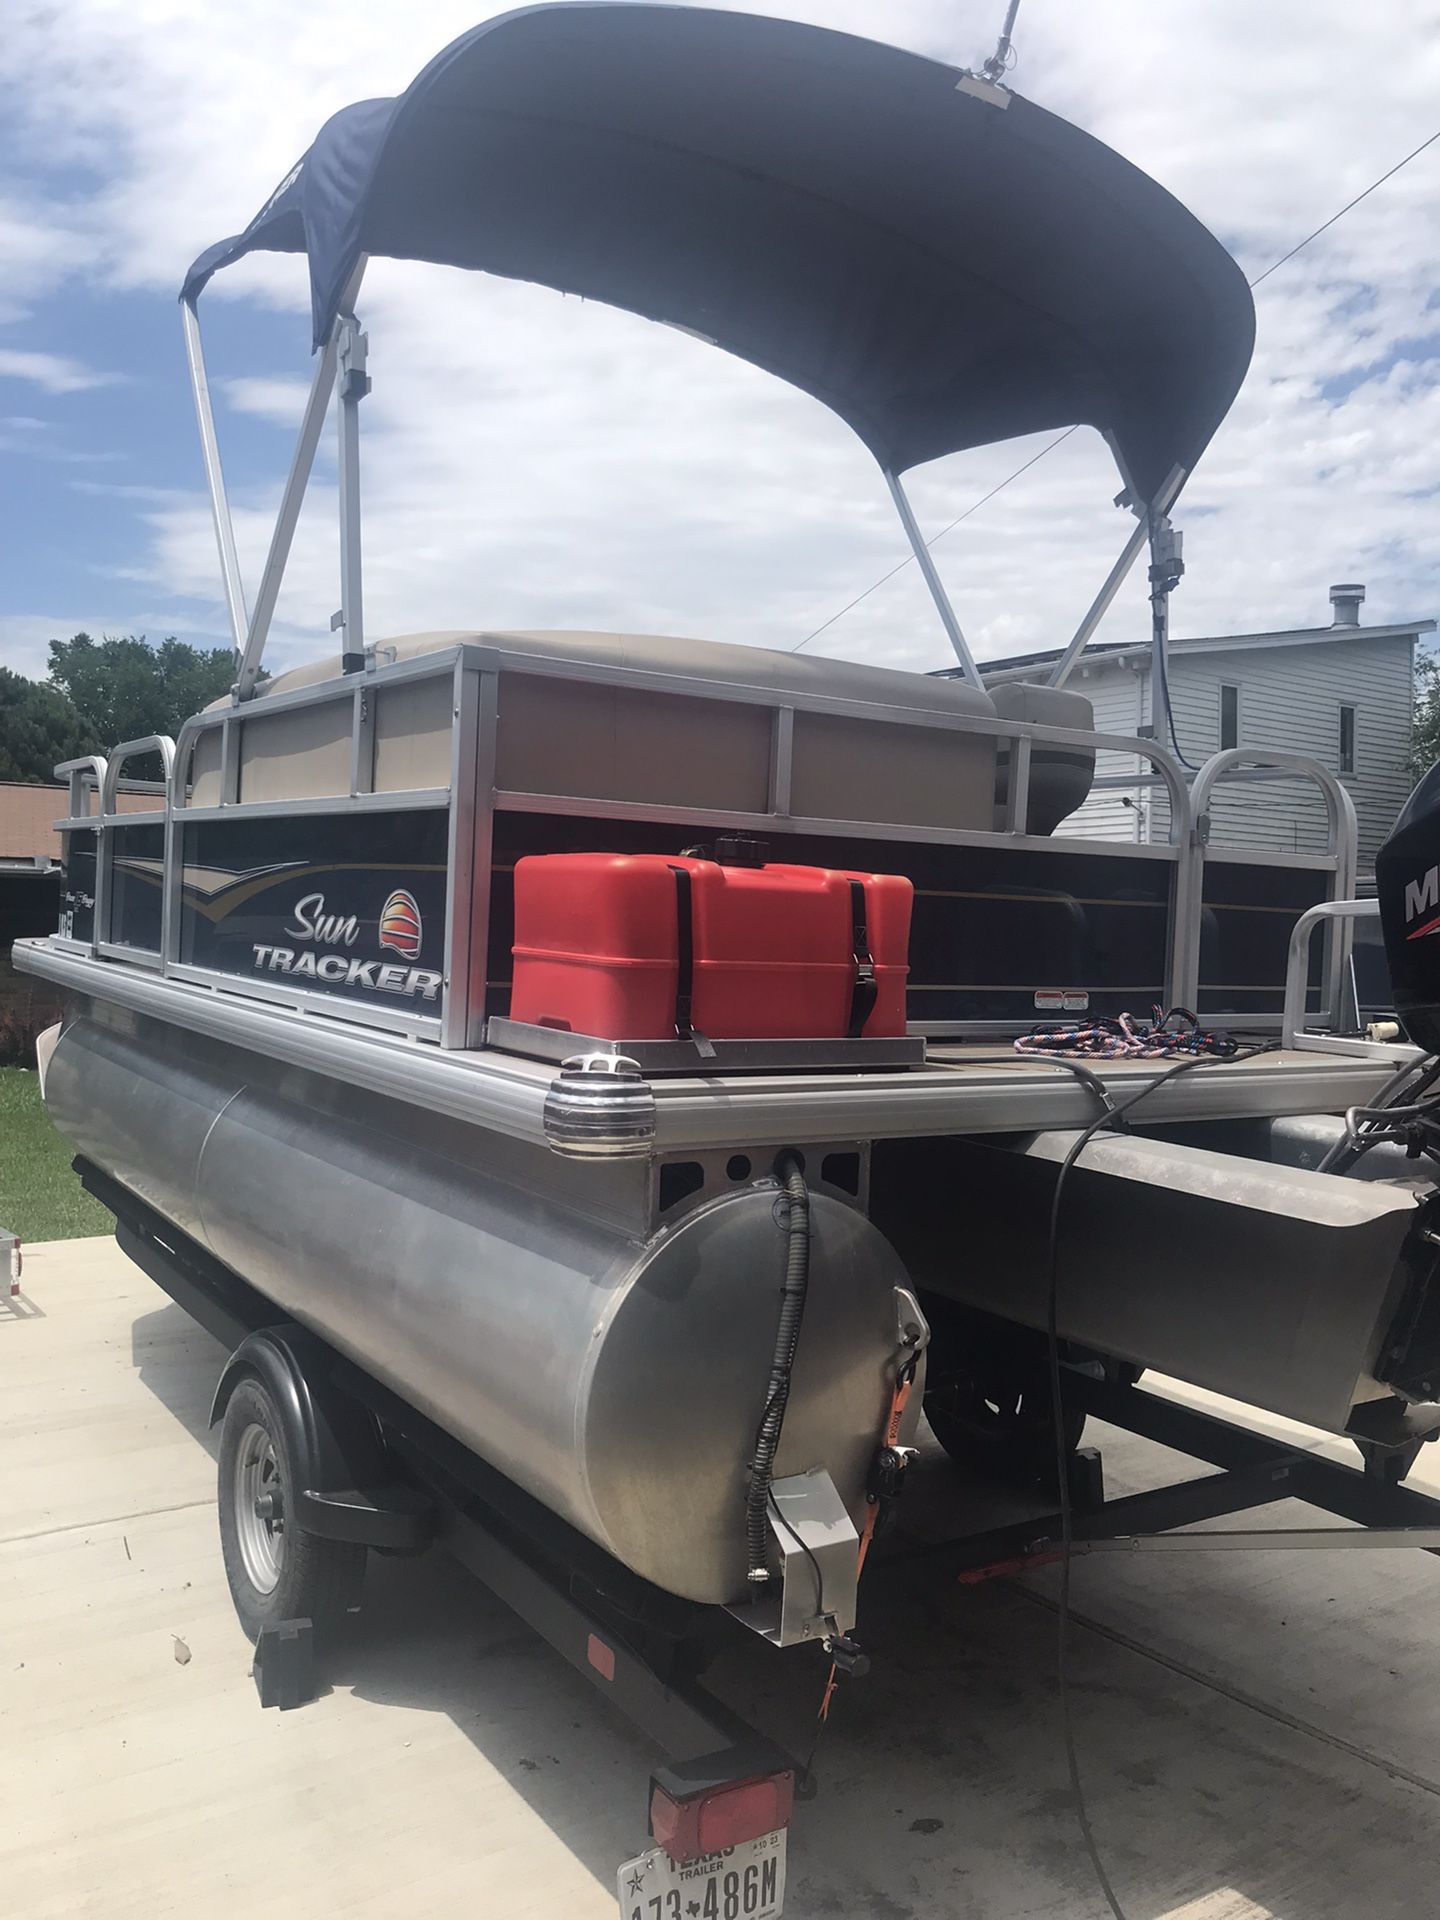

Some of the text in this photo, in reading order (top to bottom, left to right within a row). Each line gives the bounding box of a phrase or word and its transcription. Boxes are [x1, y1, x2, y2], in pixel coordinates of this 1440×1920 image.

[284, 893, 360, 946] Sun
[1405, 865, 1440, 923] M
[253, 944, 443, 1000] TRACKER
[679, 1861, 724, 1881] TRAILER
[703, 1857, 777, 1920] 486M
